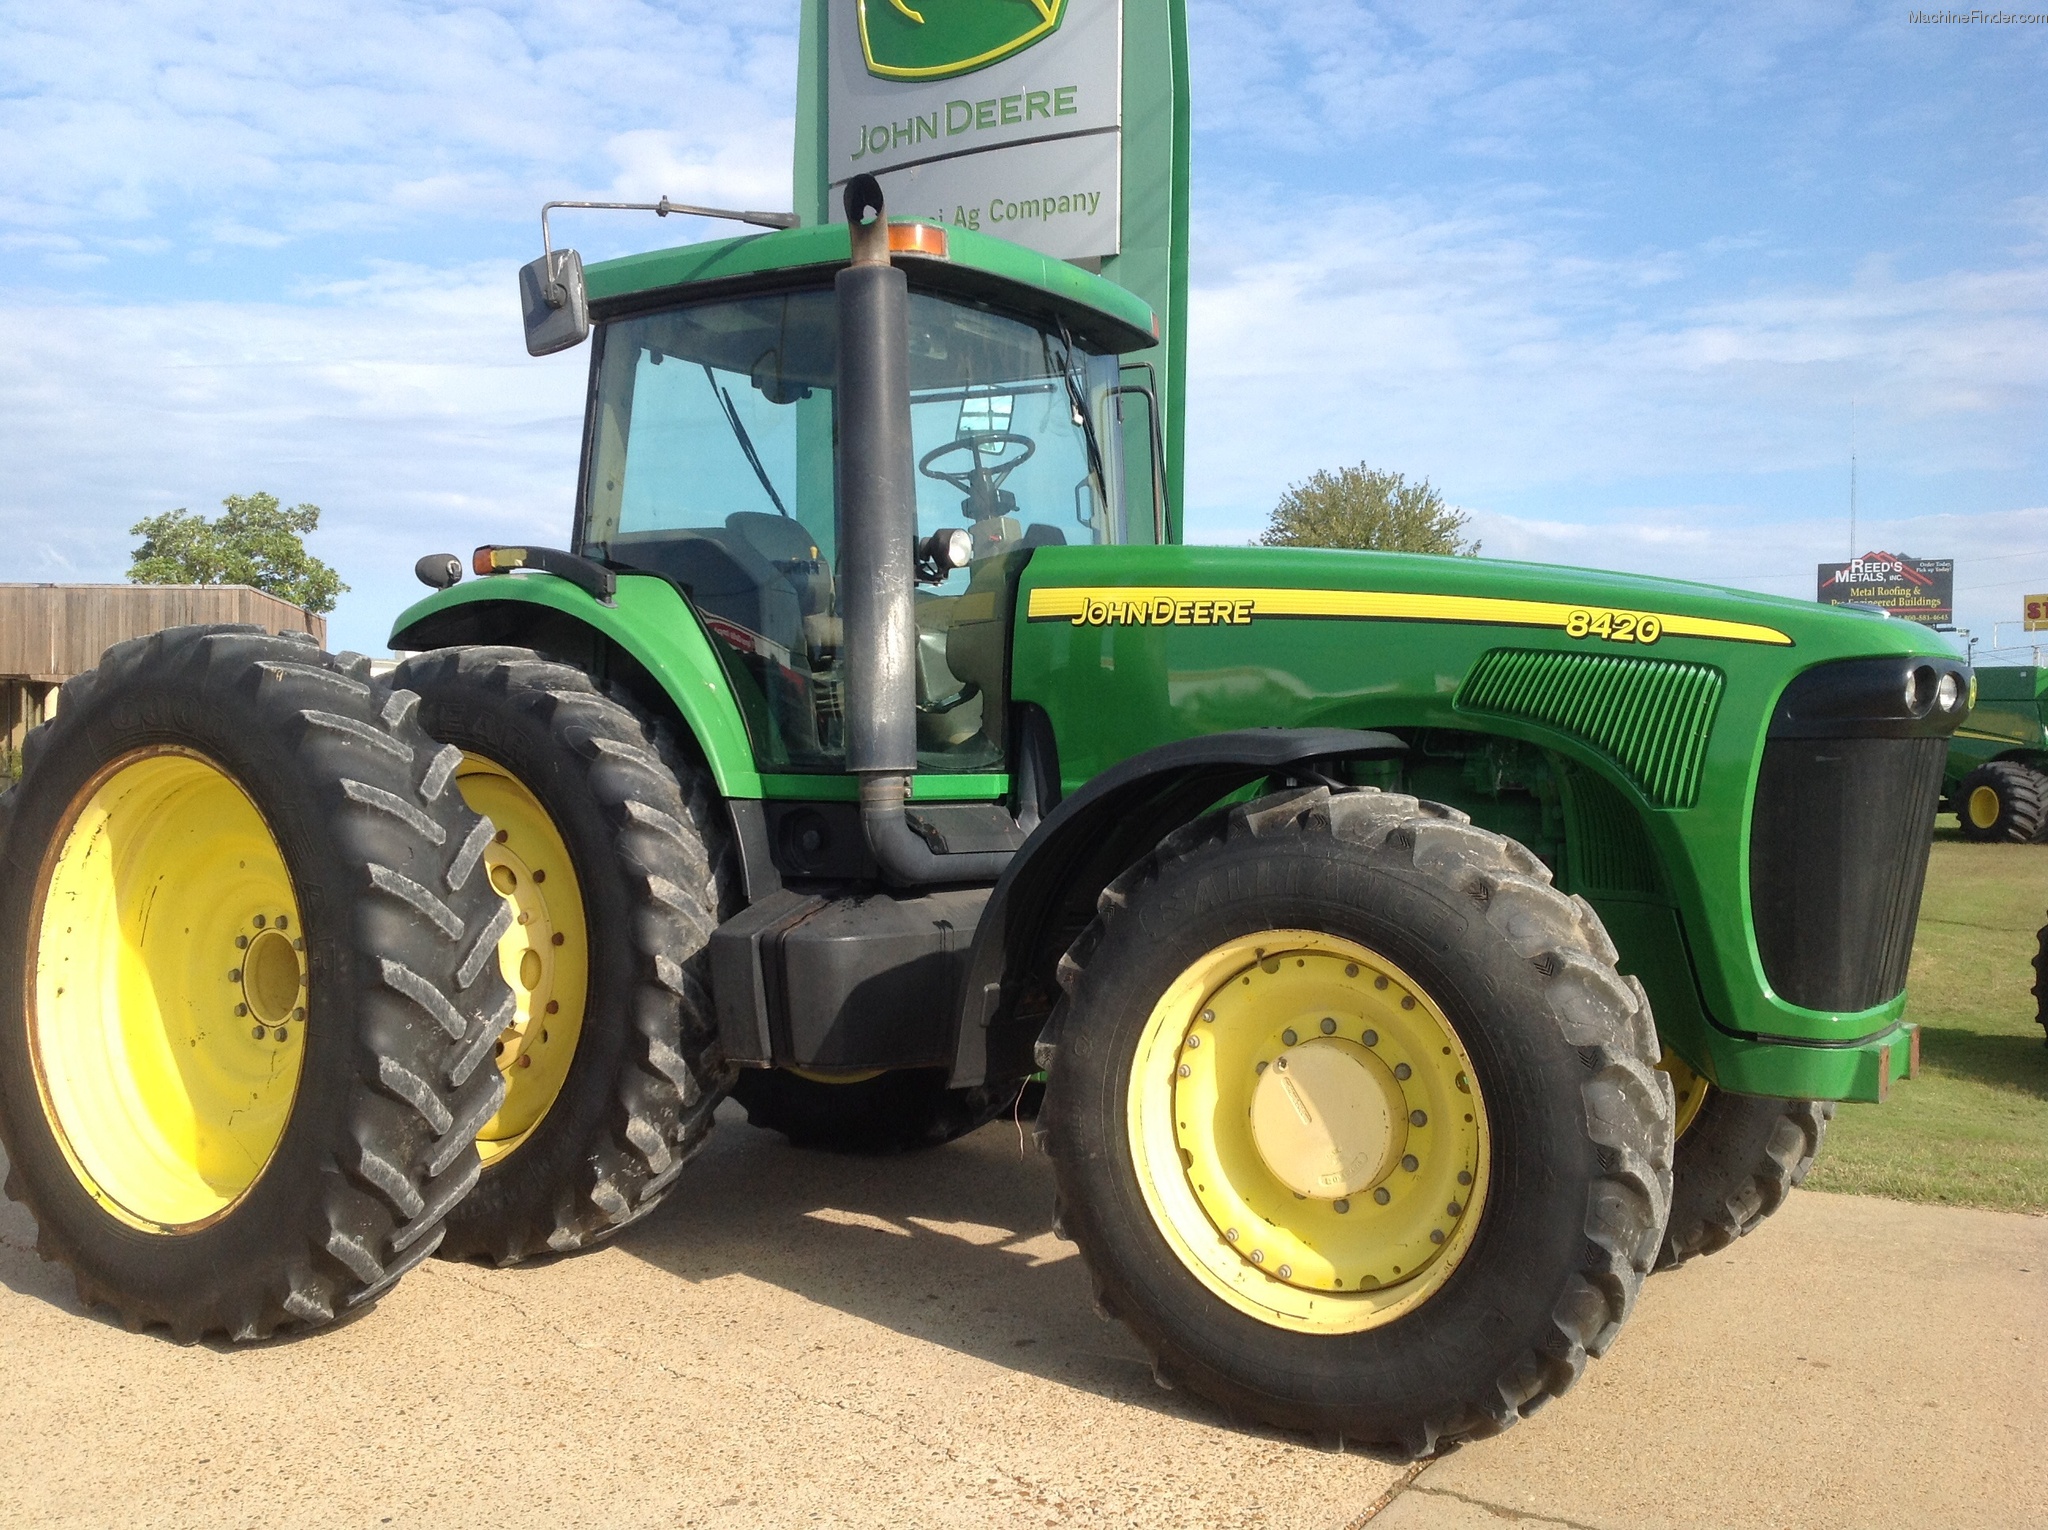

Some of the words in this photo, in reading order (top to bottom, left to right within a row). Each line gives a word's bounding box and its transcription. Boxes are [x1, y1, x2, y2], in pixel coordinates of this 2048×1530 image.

[850, 112, 938, 162] JOHN
[944, 85, 1078, 137] DEERE
[953, 205, 981, 231] Ag
[988, 191, 1101, 222] Company
[1835, 569, 1887, 583] METALS,
[1851, 559, 1903, 573] REED'S
[1850, 586, 1875, 597] Metal
[1877, 586, 1912, 598] Roofing
[1913, 586, 1921, 595] &
[1898, 597, 1942, 608] Buildings
[1071, 597, 1148, 627] JOHN
[1150, 596, 1255, 627] DEERE
[1566, 609, 1662, 645] 8420
